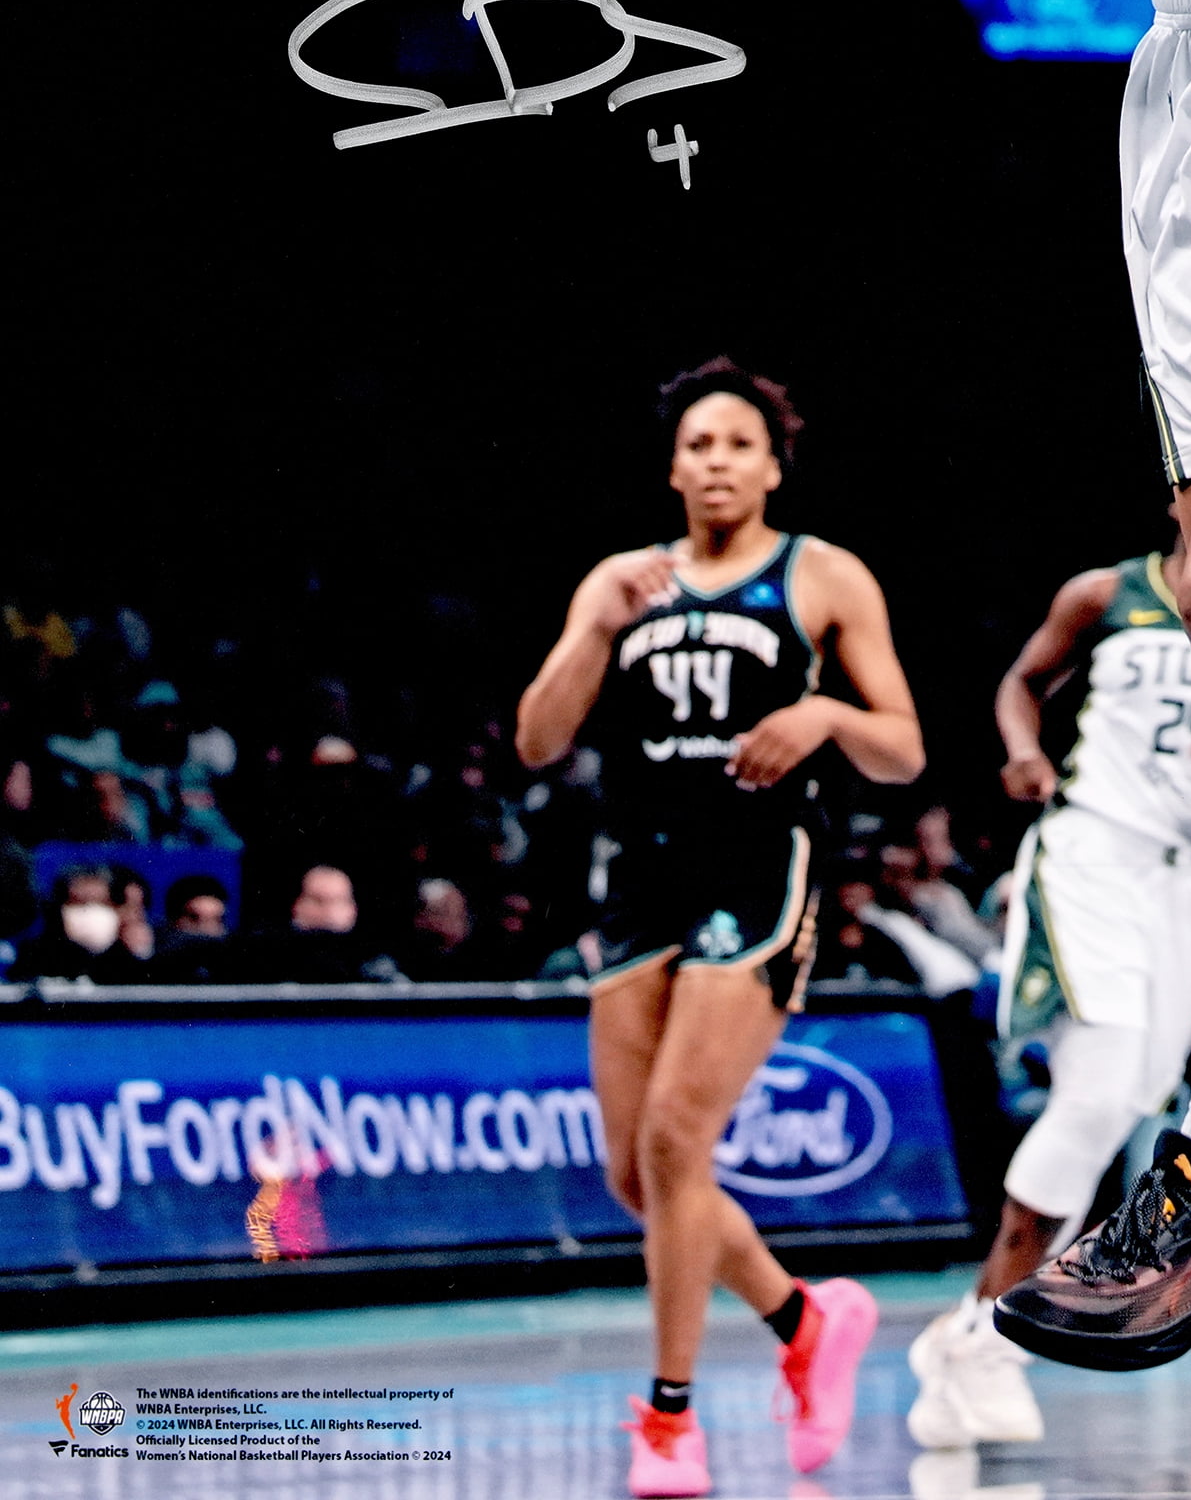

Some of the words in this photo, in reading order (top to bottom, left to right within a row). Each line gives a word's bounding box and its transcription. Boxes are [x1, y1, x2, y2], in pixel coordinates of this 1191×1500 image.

[646, 122, 700, 191] 4
[648, 648, 734, 723] 44
[0, 1072, 608, 1211] BuyFordNow.com
[713, 1064, 855, 1169] Ford
